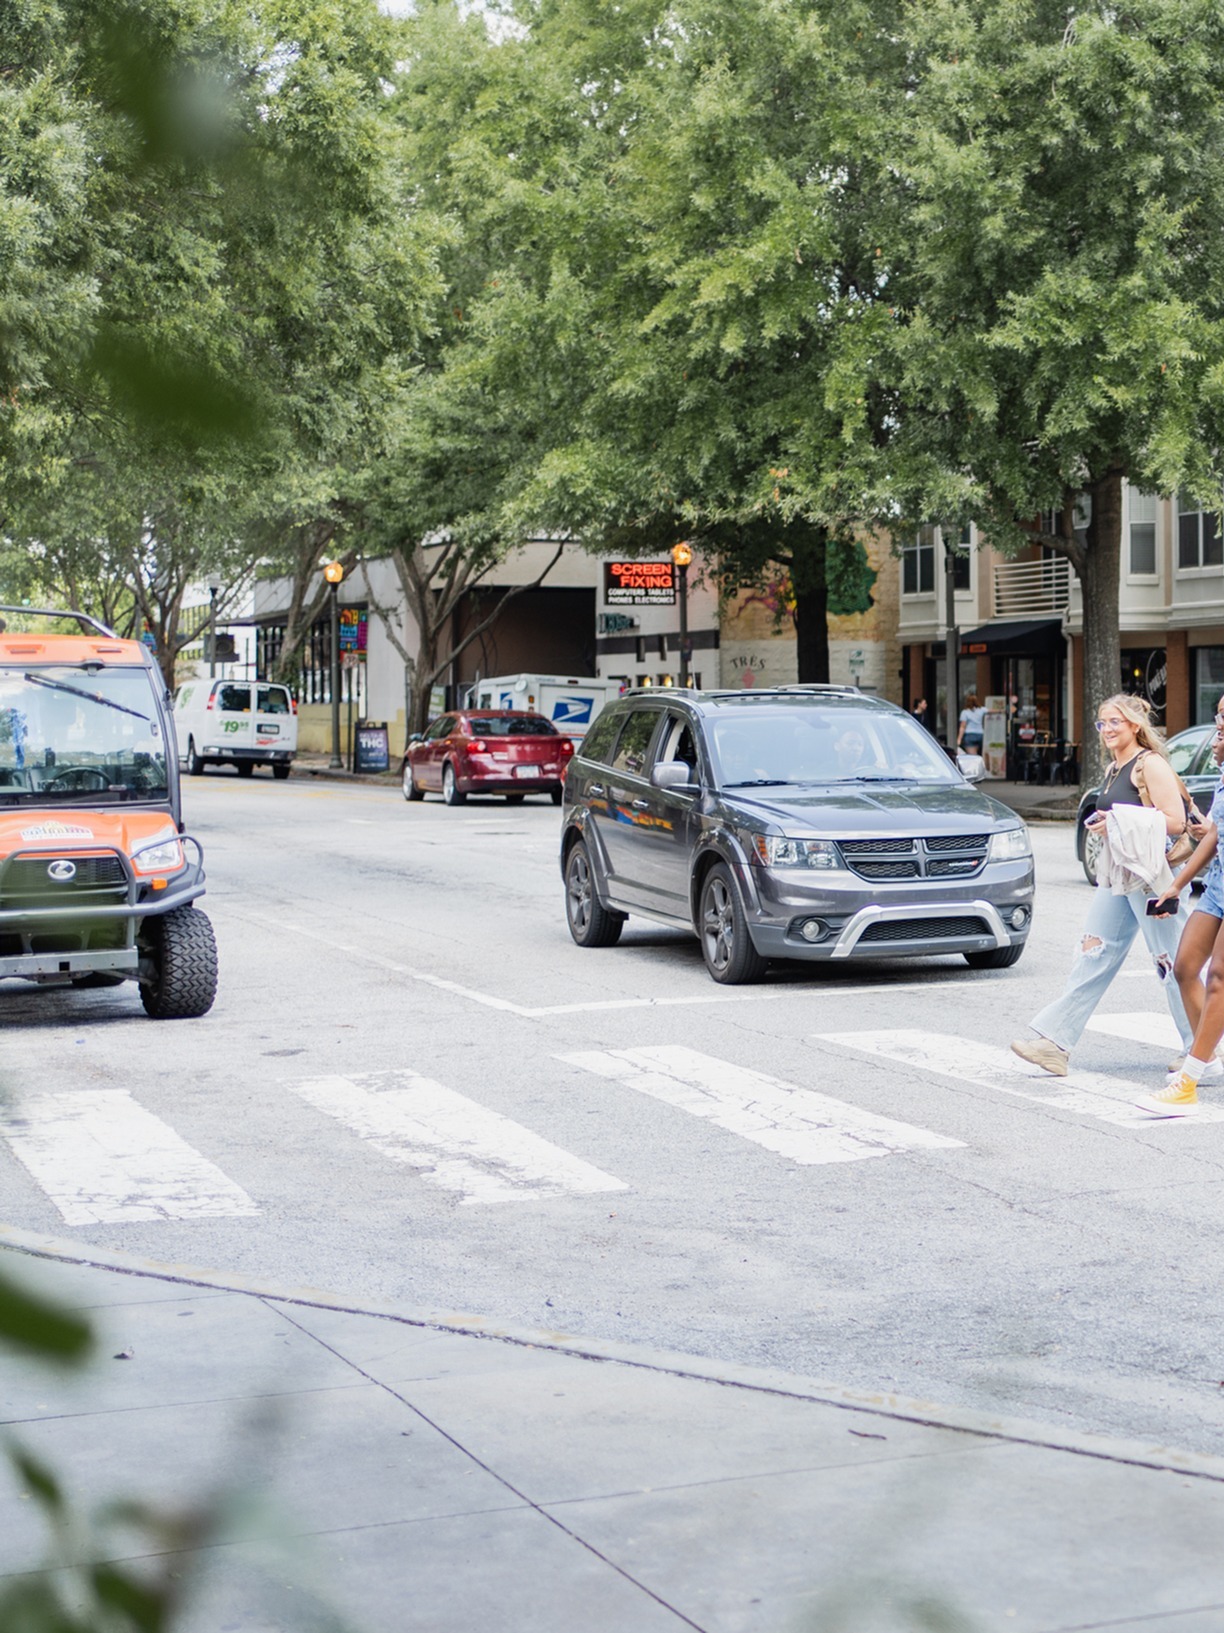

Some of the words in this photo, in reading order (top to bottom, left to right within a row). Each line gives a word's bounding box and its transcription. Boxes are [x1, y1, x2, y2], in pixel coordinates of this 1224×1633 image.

[611, 563, 672, 575] SCREEN
[620, 575, 673, 587] FIXING
[608, 588, 646, 596] COMPUTERS
[648, 588, 674, 596] TABLETS
[608, 596, 632, 604] PHONES
[635, 596, 674, 604] ELECTRONICS
[360, 738, 384, 748] THC
